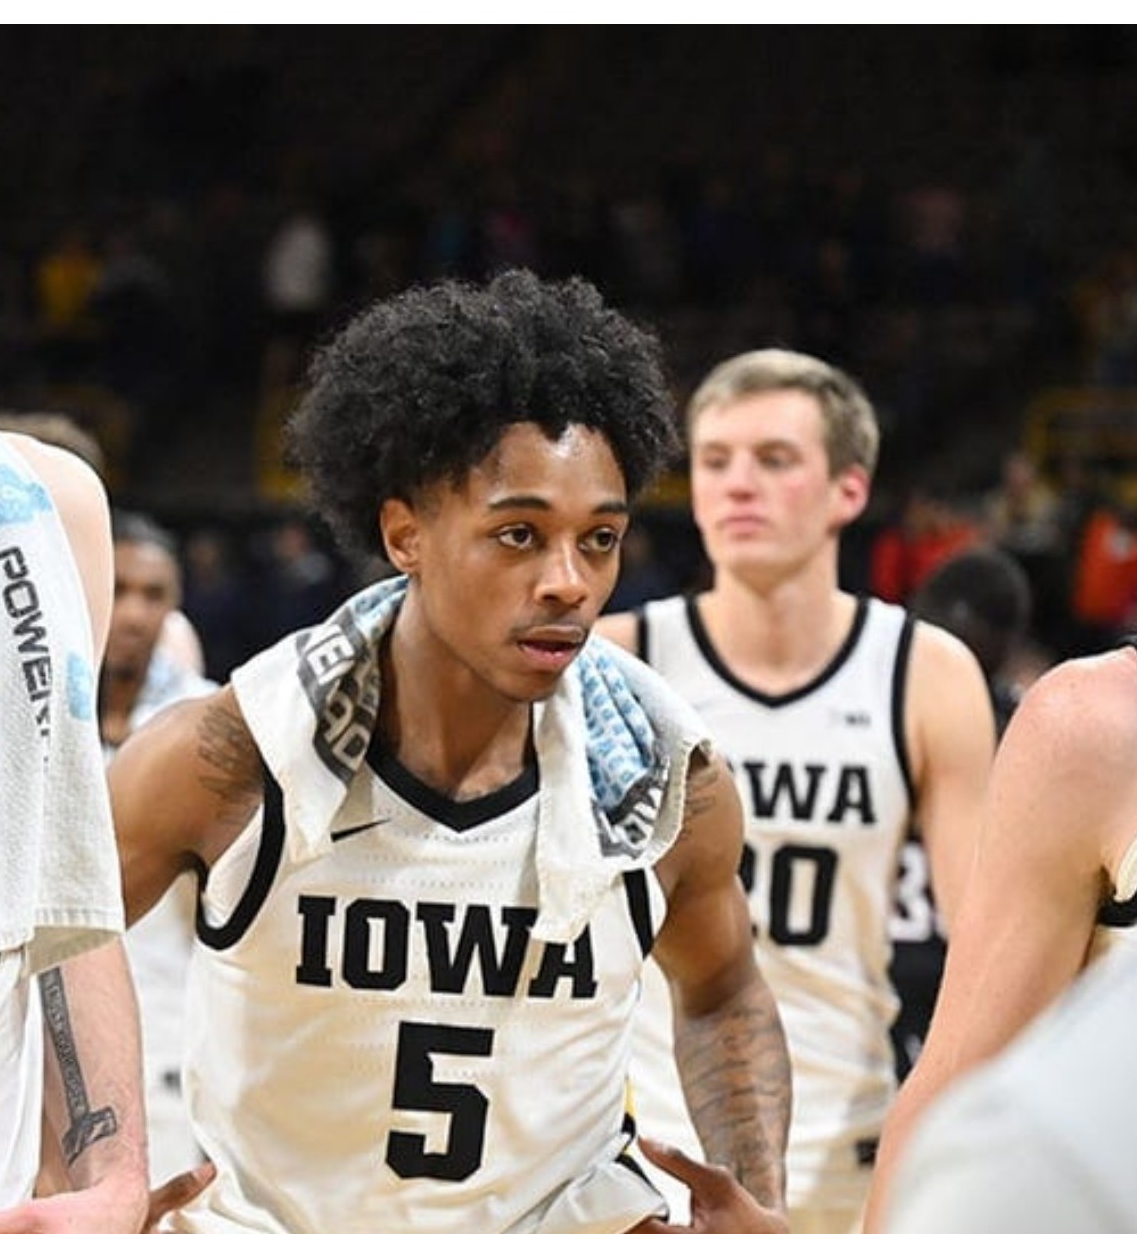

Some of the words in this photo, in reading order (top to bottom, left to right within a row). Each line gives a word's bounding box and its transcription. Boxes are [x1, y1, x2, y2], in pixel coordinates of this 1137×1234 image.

[728, 761, 877, 825] WA
[296, 894, 598, 999] IOWA
[385, 1021, 495, 1183] 5
